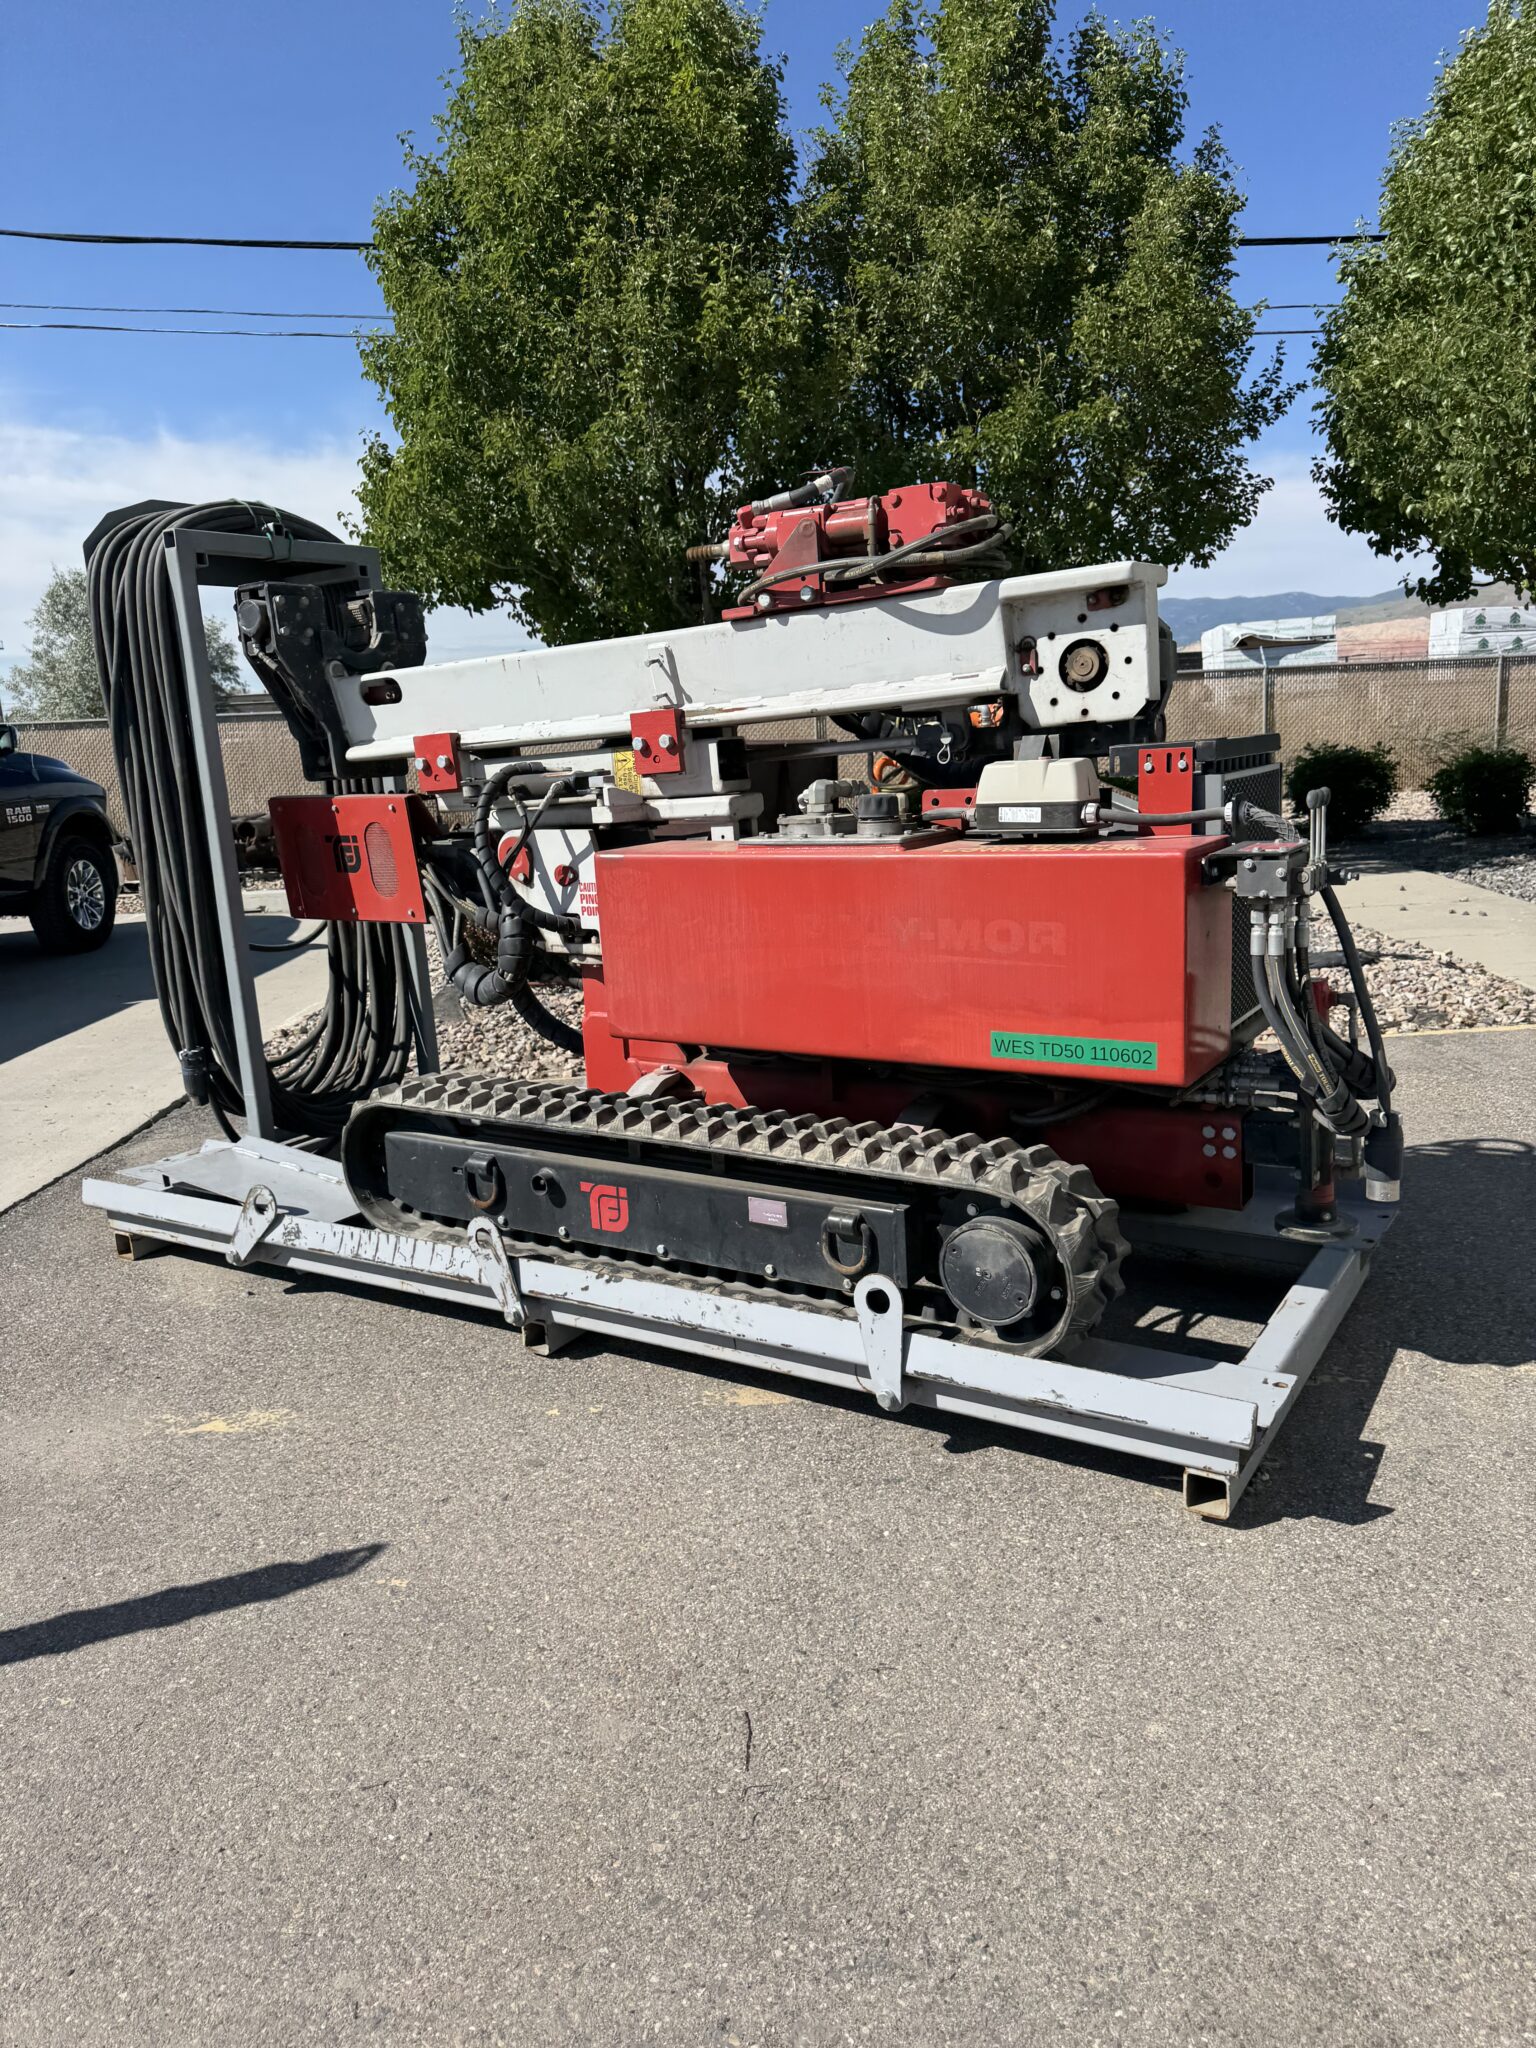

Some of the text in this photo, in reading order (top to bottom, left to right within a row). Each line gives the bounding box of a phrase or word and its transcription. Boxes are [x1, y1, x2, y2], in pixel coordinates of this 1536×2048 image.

[6, 806, 31, 815] RAM
[6, 814, 32, 823] 1500
[994, 1038, 1153, 1065] WES TD50 110602
